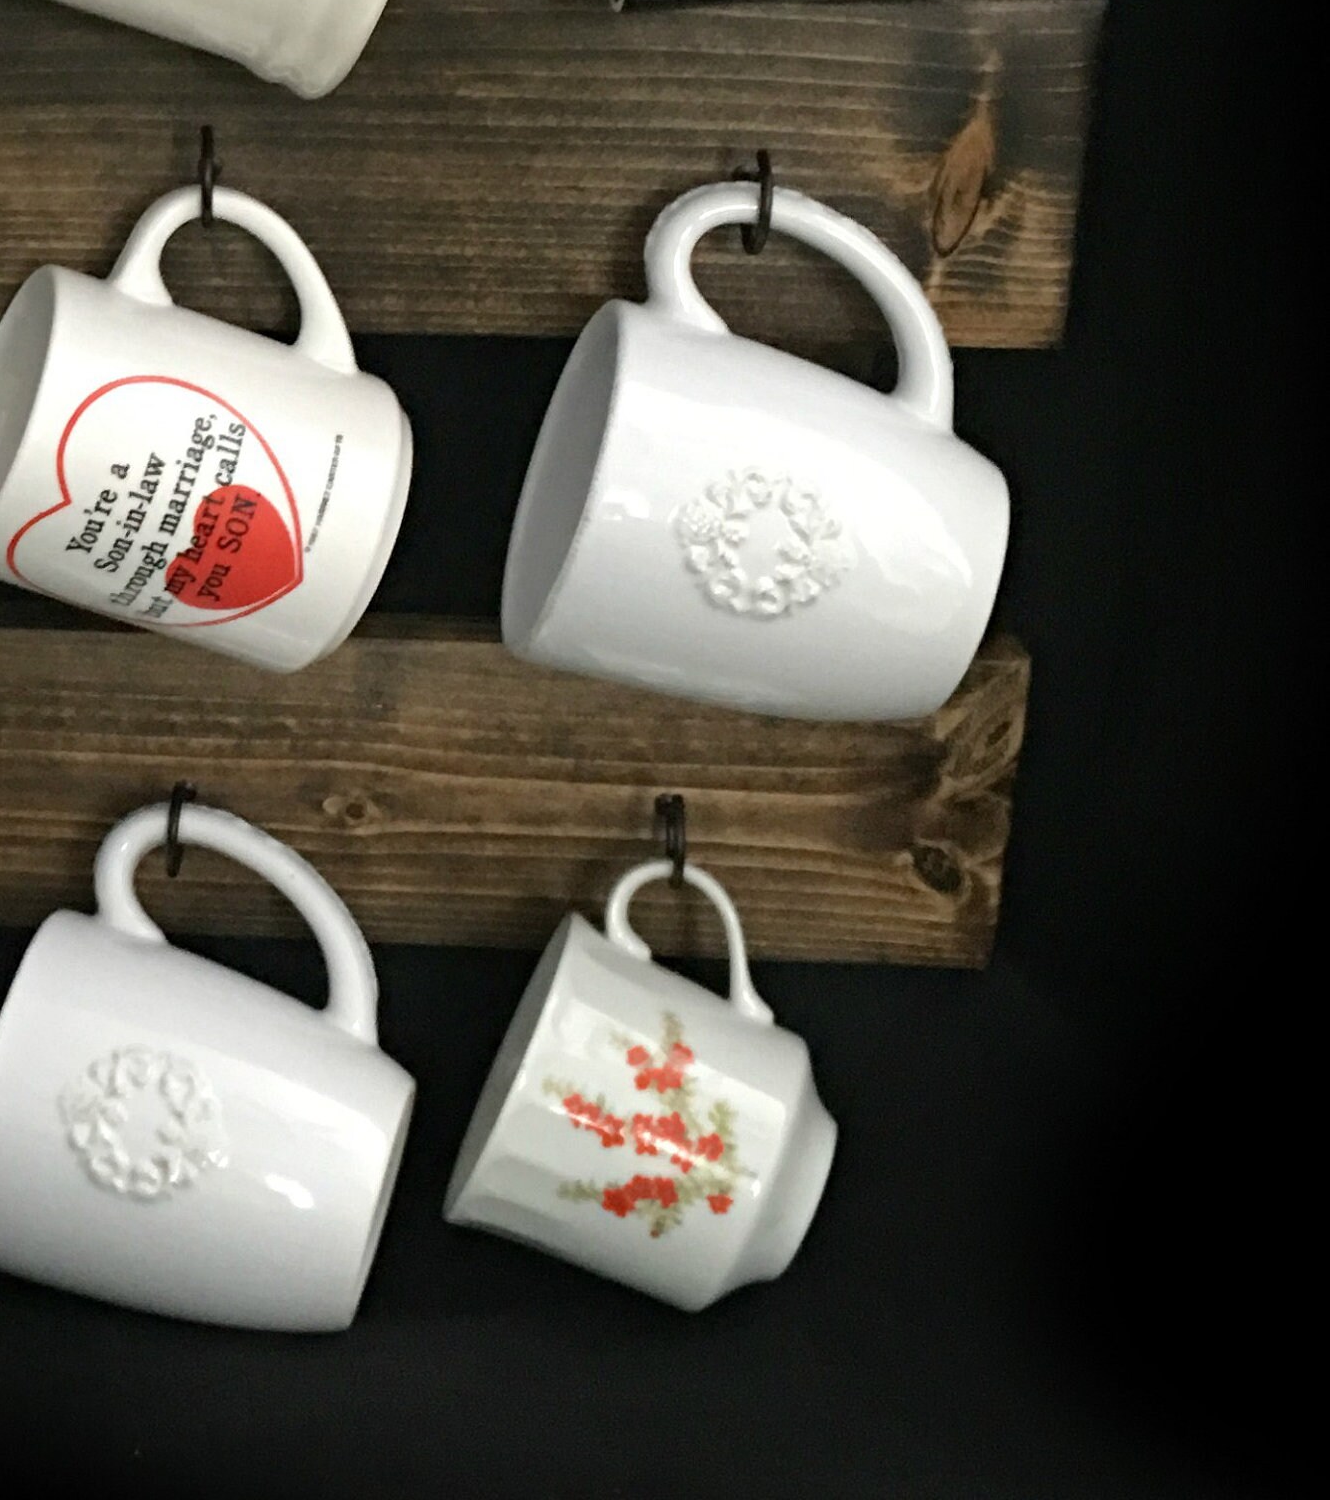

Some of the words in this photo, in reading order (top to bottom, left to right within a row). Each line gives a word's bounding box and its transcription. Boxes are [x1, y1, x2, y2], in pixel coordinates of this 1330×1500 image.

[214, 422, 247, 487] calls
[66, 488, 119, 554] You're
[110, 462, 131, 480] a
[93, 451, 167, 573] Son-in-law
[110, 540, 170, 607] through
[158, 413, 219, 536] marriage,
[175, 493, 227, 565] heart
[164, 564, 198, 596] my
[197, 562, 231, 603] you
